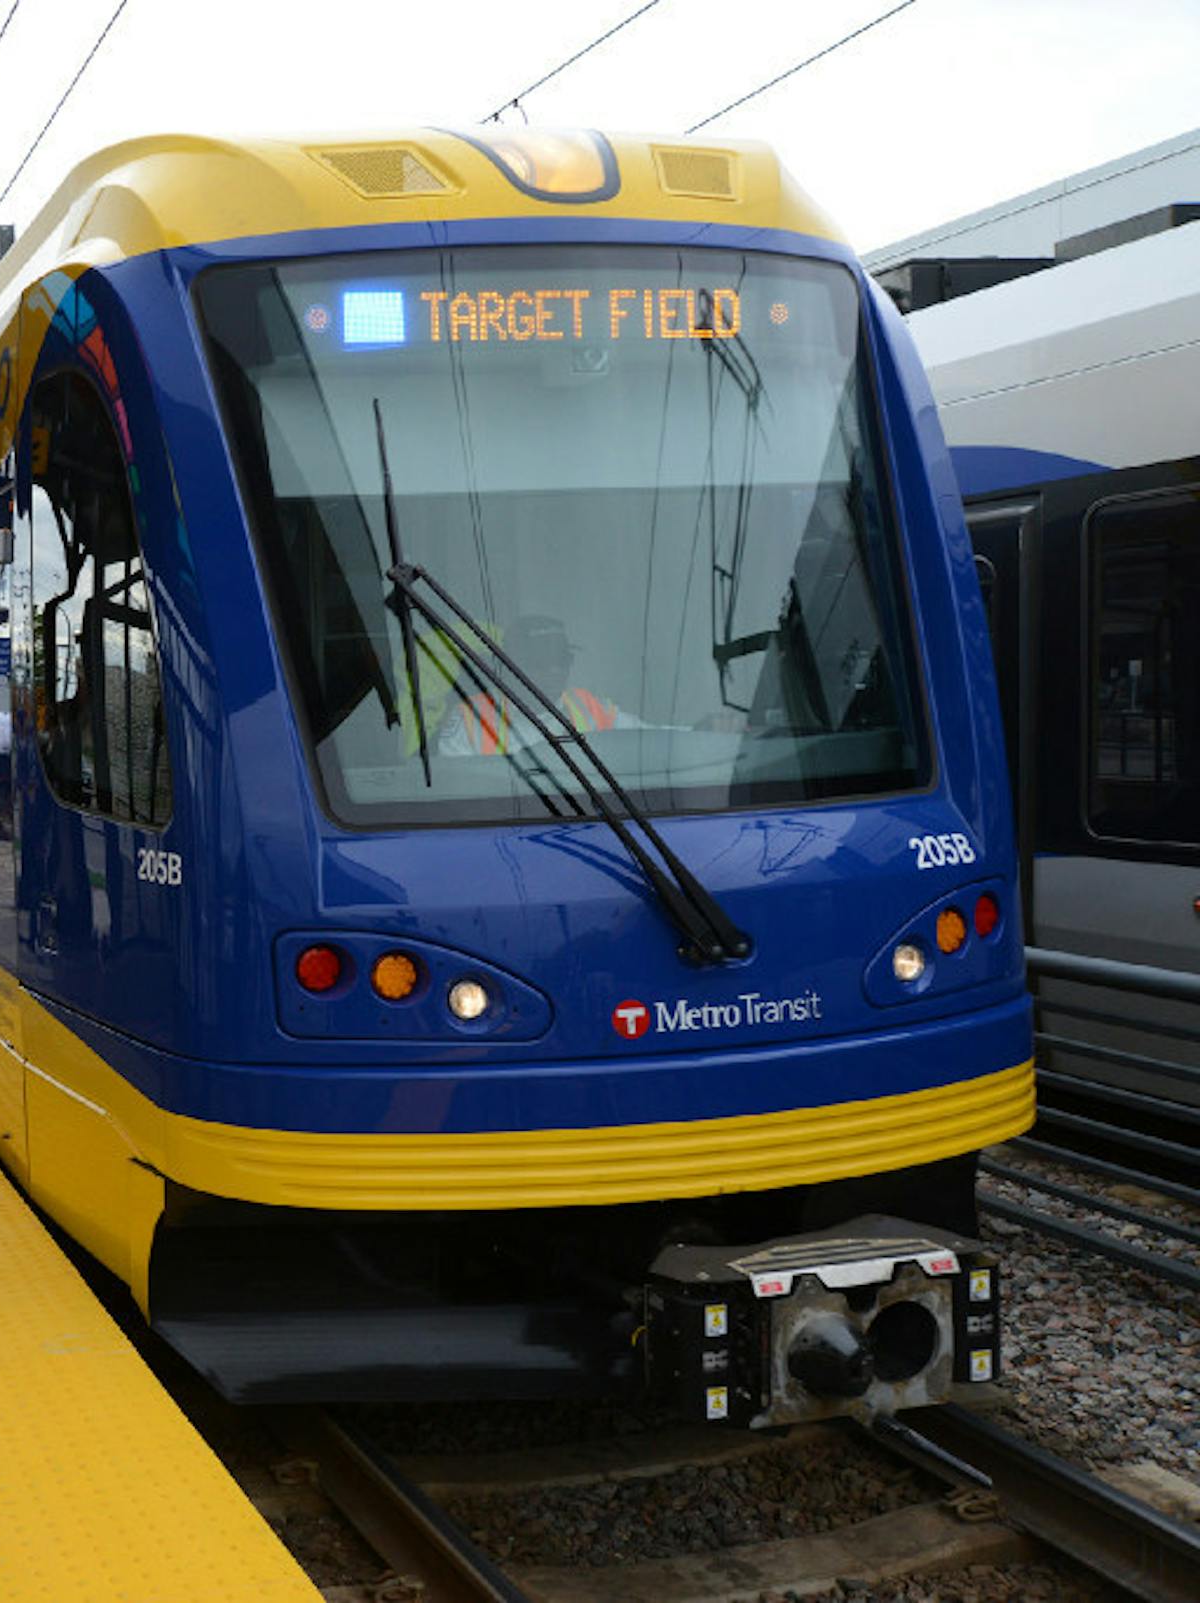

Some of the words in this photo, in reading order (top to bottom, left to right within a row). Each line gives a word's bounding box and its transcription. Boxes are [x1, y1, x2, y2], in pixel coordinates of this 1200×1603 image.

[420, 290, 590, 341] TARGET
[608, 288, 741, 341] FIELD
[136, 847, 183, 886] 205B
[908, 832, 977, 870] 205B
